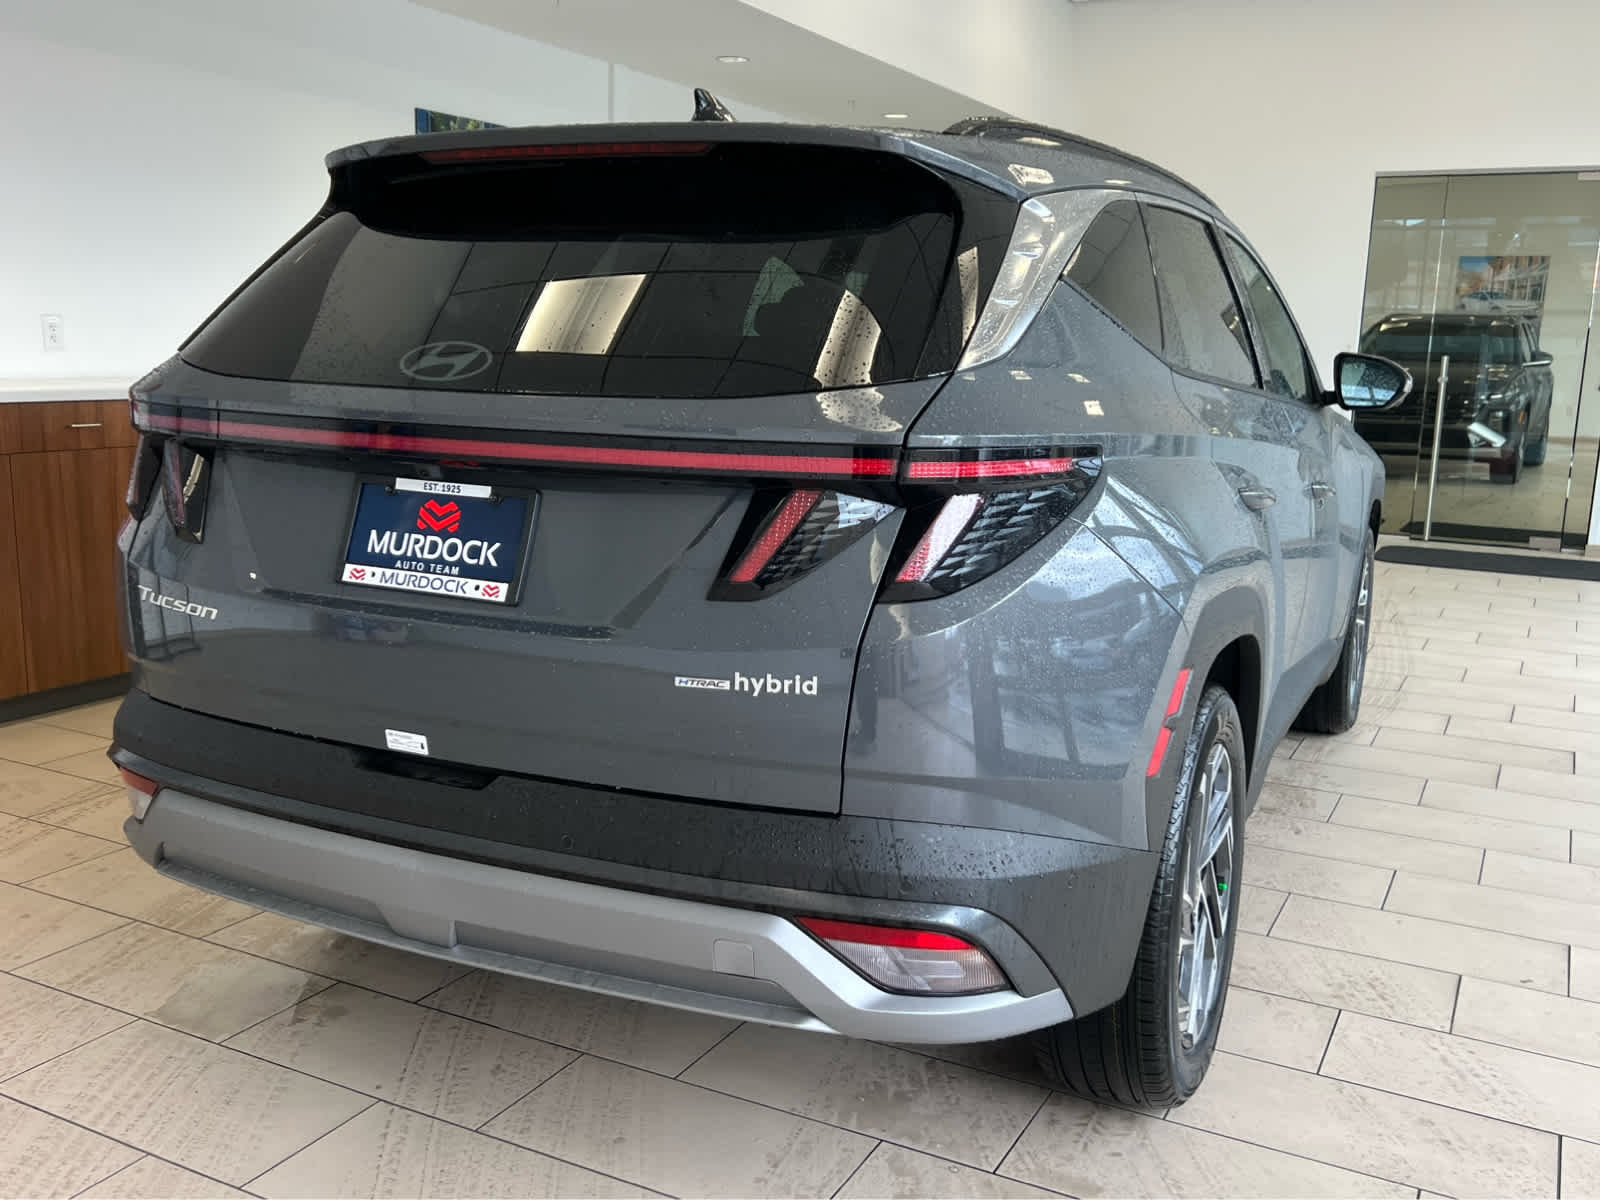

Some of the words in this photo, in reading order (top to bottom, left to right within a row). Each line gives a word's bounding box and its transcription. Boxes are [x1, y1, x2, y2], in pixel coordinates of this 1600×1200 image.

[441, 484, 462, 494] 1925
[367, 529, 501, 567] MURDOCK
[395, 560, 425, 571] AUTO
[430, 563, 460, 575] TEAM
[379, 570, 469, 594] MURDOCK
[734, 671, 818, 697] hybrid
